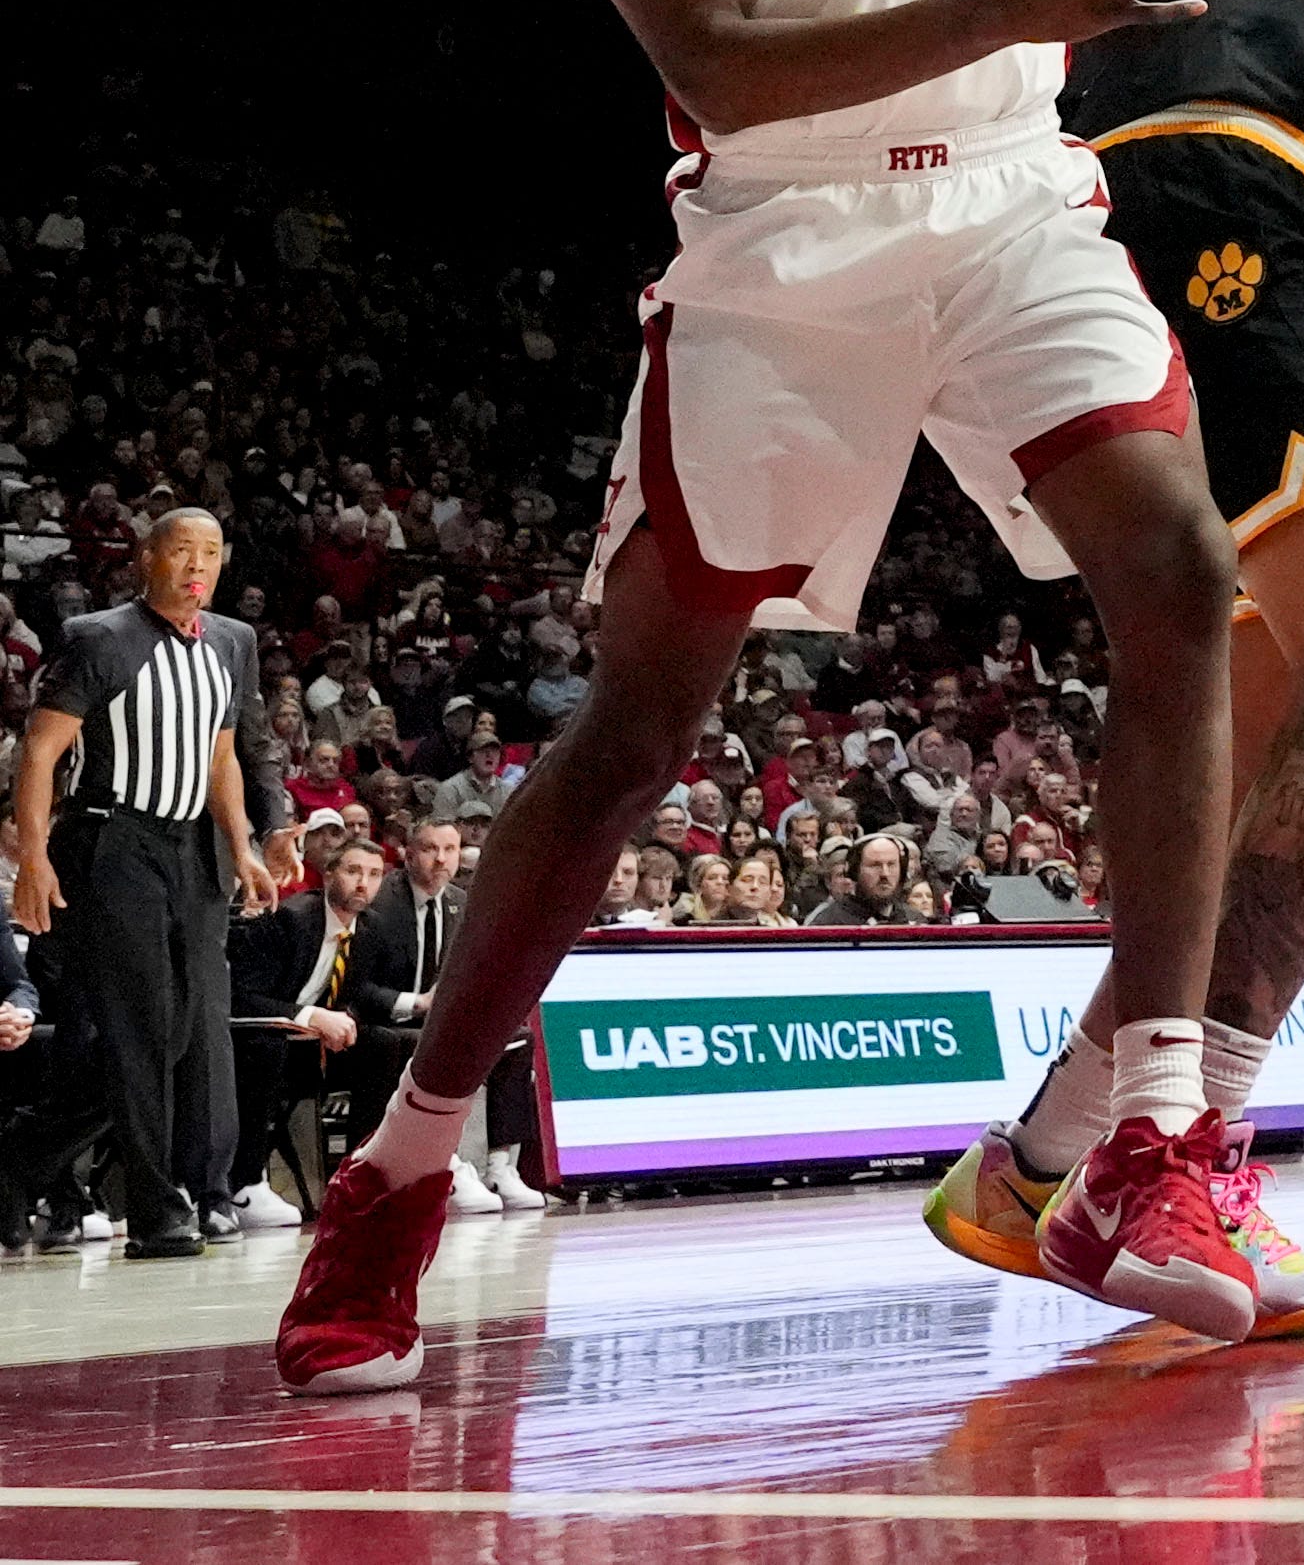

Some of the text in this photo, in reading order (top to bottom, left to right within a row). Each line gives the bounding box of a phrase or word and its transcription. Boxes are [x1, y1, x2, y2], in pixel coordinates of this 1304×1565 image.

[888, 143, 948, 170] RTR
[580, 1017, 958, 1072] UAB ST. VINCENT'S
[1018, 1006, 1073, 1056] UA
